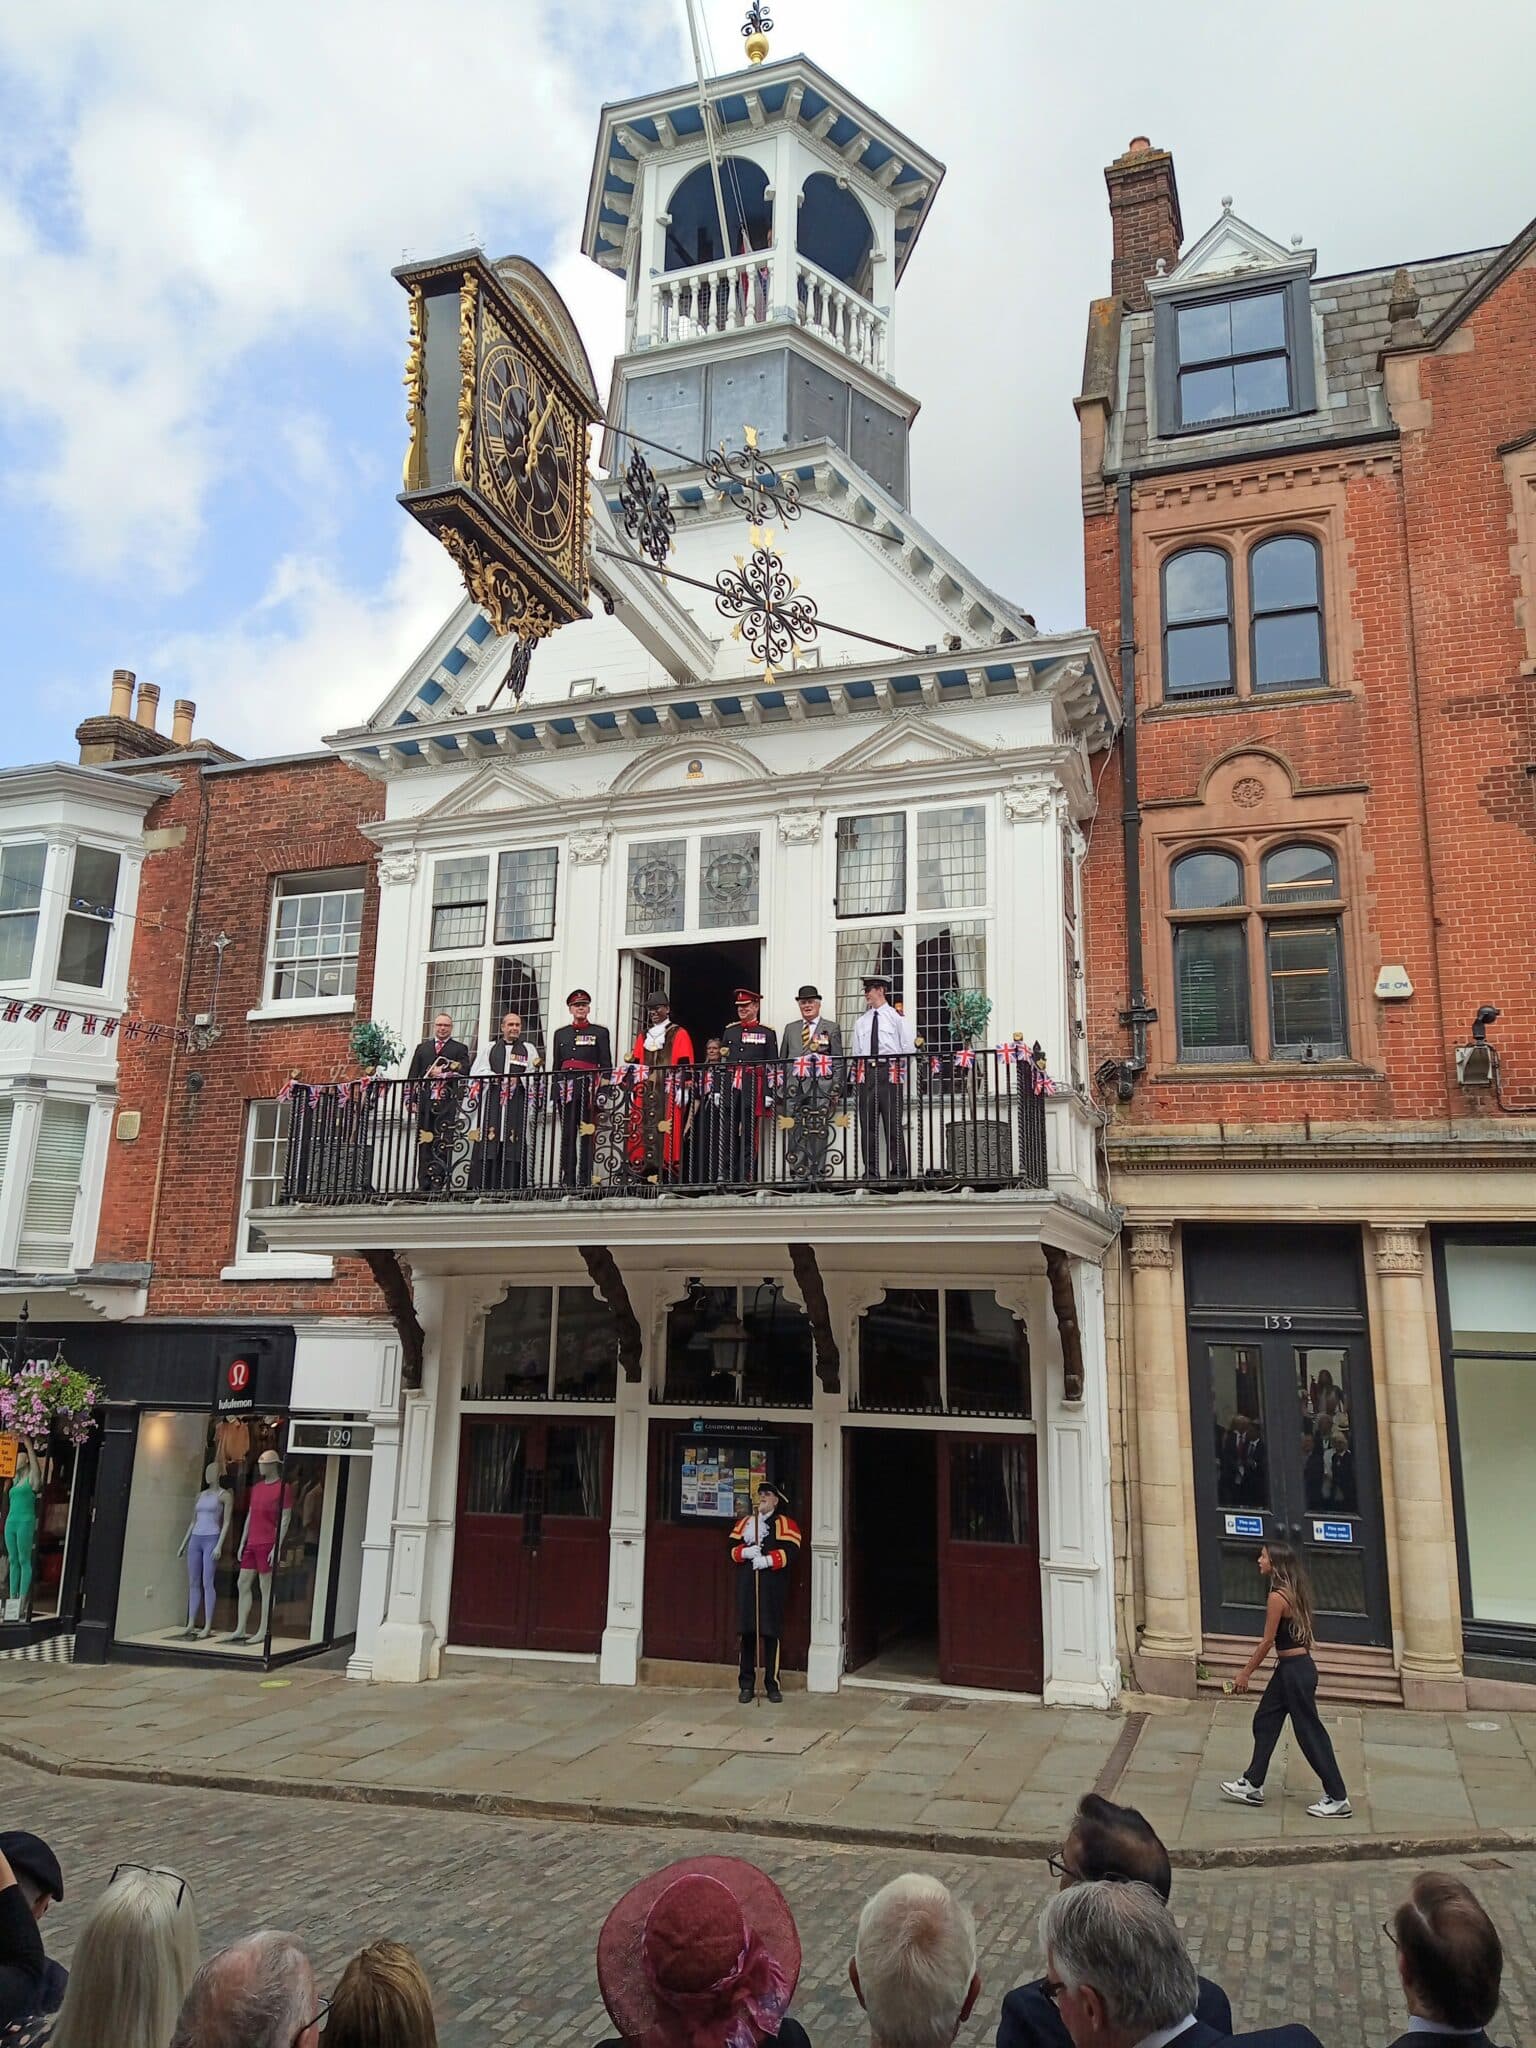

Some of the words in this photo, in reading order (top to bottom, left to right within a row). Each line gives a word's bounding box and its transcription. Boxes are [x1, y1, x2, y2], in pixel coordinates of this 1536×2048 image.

[1264, 1315, 1292, 1330] 133
[218, 1398, 253, 1410] lululemon
[326, 1429, 352, 1448] 129
